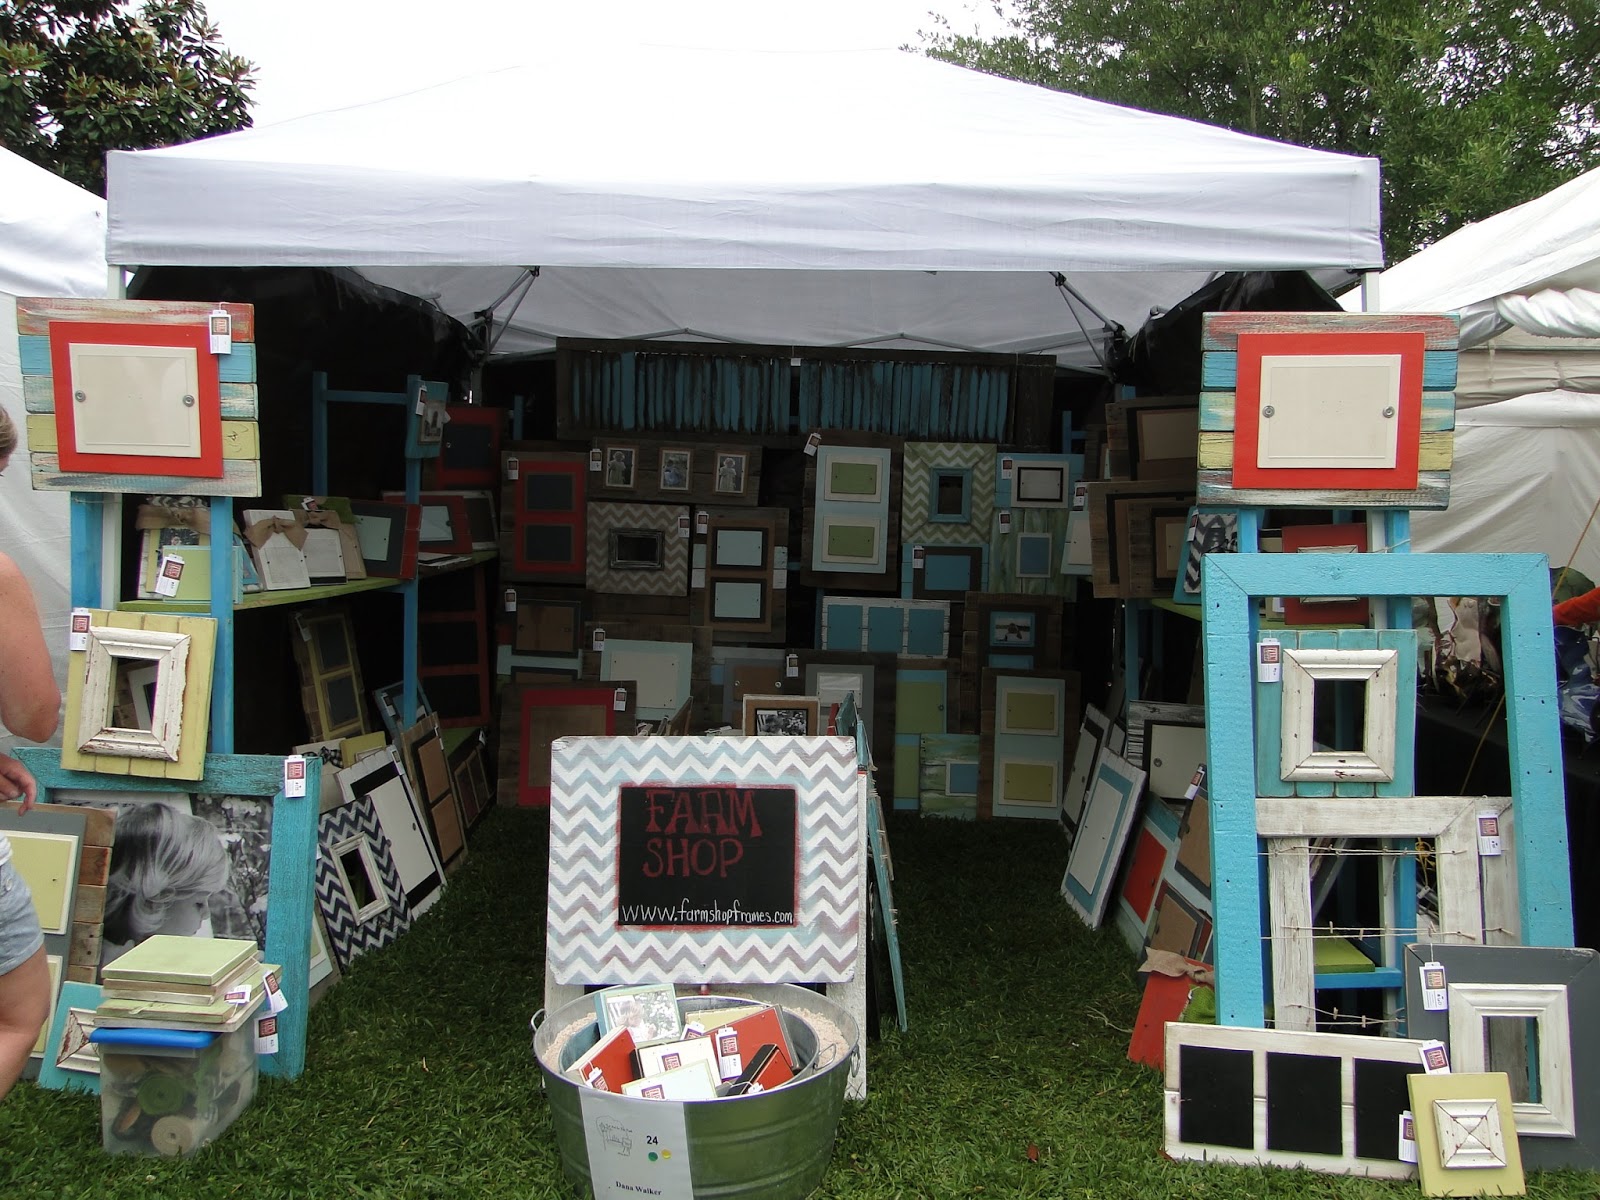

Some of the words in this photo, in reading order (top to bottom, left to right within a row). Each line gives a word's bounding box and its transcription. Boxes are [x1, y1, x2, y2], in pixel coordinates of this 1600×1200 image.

[645, 789, 763, 837] FARM
[642, 837, 744, 878] SHOP
[621, 897, 793, 925] www.farmshopframes.com
[646, 1135, 659, 1146] 24
[615, 1181, 634, 1192] Dana
